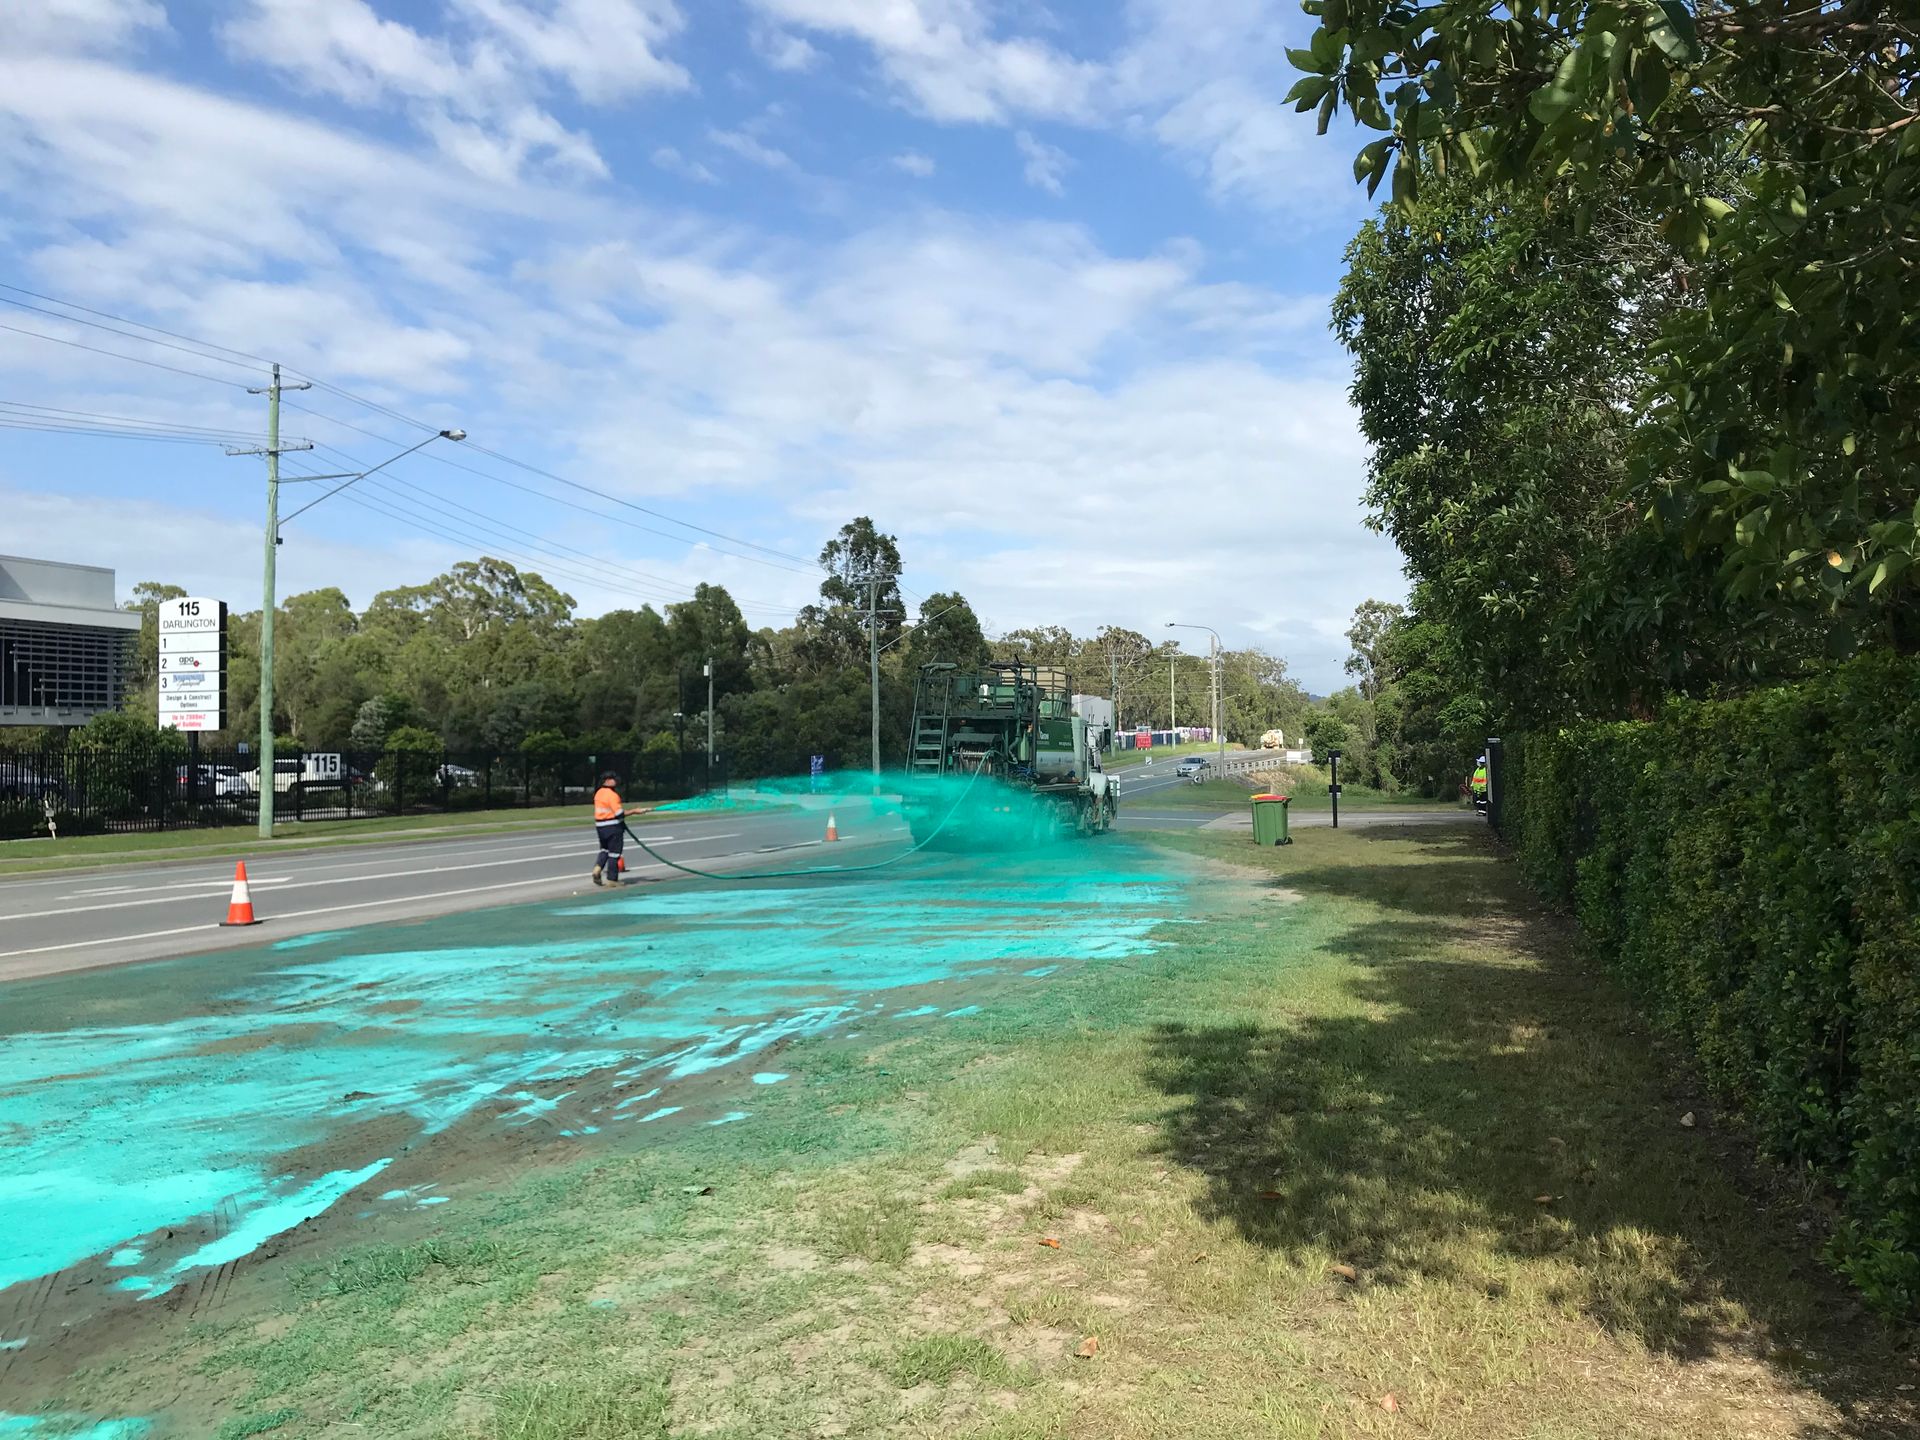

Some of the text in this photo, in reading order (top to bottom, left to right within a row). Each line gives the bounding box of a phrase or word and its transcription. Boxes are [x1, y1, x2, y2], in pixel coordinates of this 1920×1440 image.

[178, 602, 200, 616] 115
[163, 618, 216, 628] DARLINGTON
[163, 638, 166, 648] 1
[162, 658, 167, 669] 2
[162, 677, 167, 688] 3
[314, 756, 338, 772] 115
